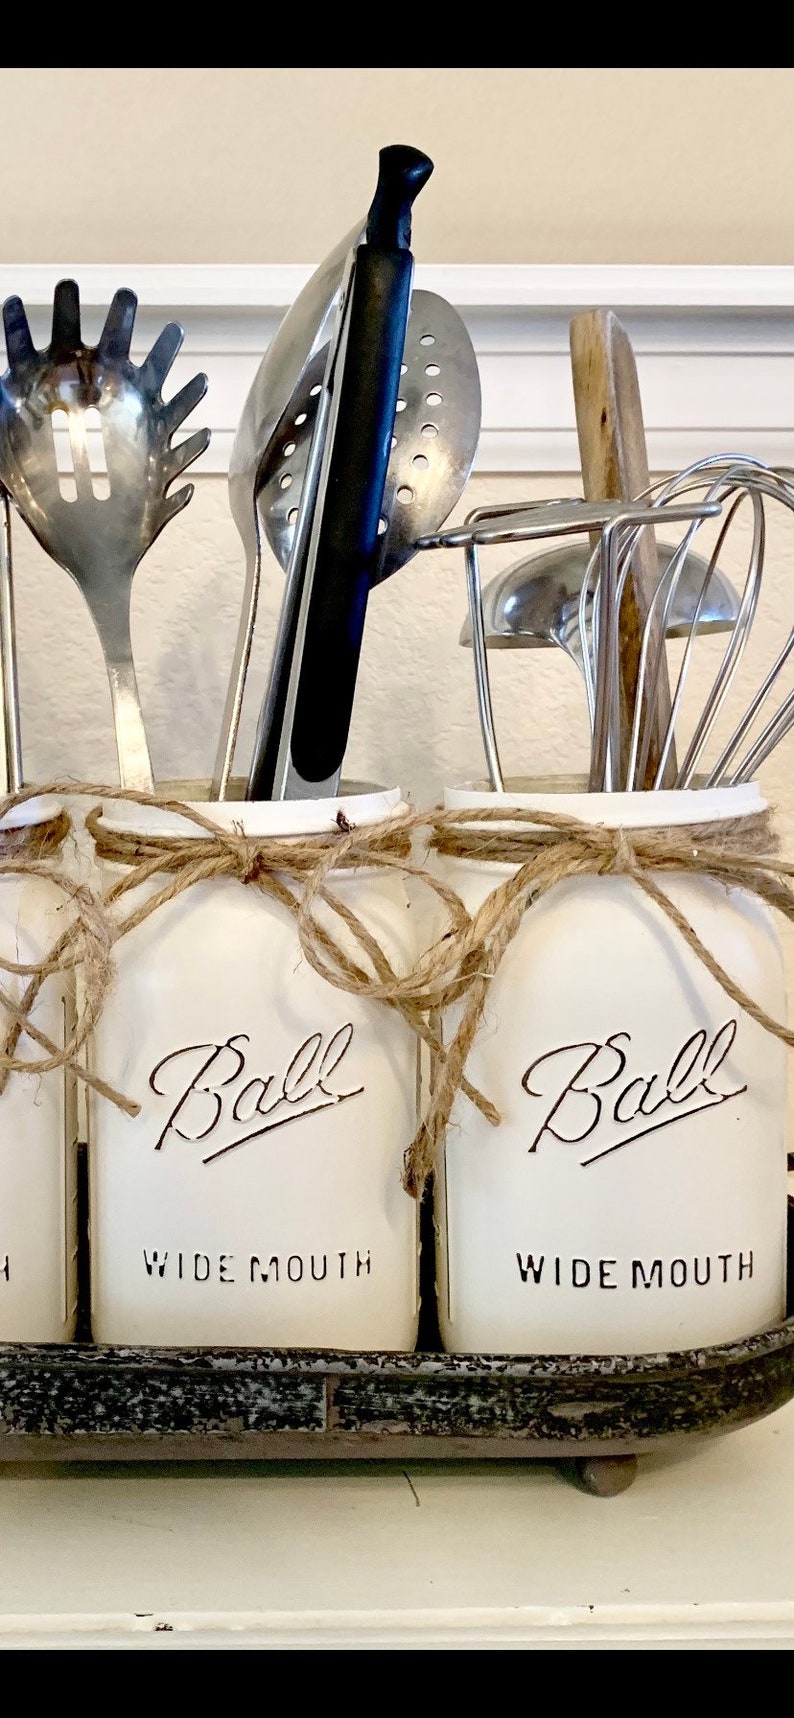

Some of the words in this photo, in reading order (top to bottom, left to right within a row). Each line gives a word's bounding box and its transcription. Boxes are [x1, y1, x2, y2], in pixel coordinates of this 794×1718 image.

[149, 1022, 365, 1164] Ball
[521, 1018, 748, 1167] Ball
[143, 1249, 235, 1283] WIDE
[250, 1249, 371, 1283] MOUTH
[516, 1252, 618, 1289] WIDE
[631, 1250, 754, 1289] MOUTH
